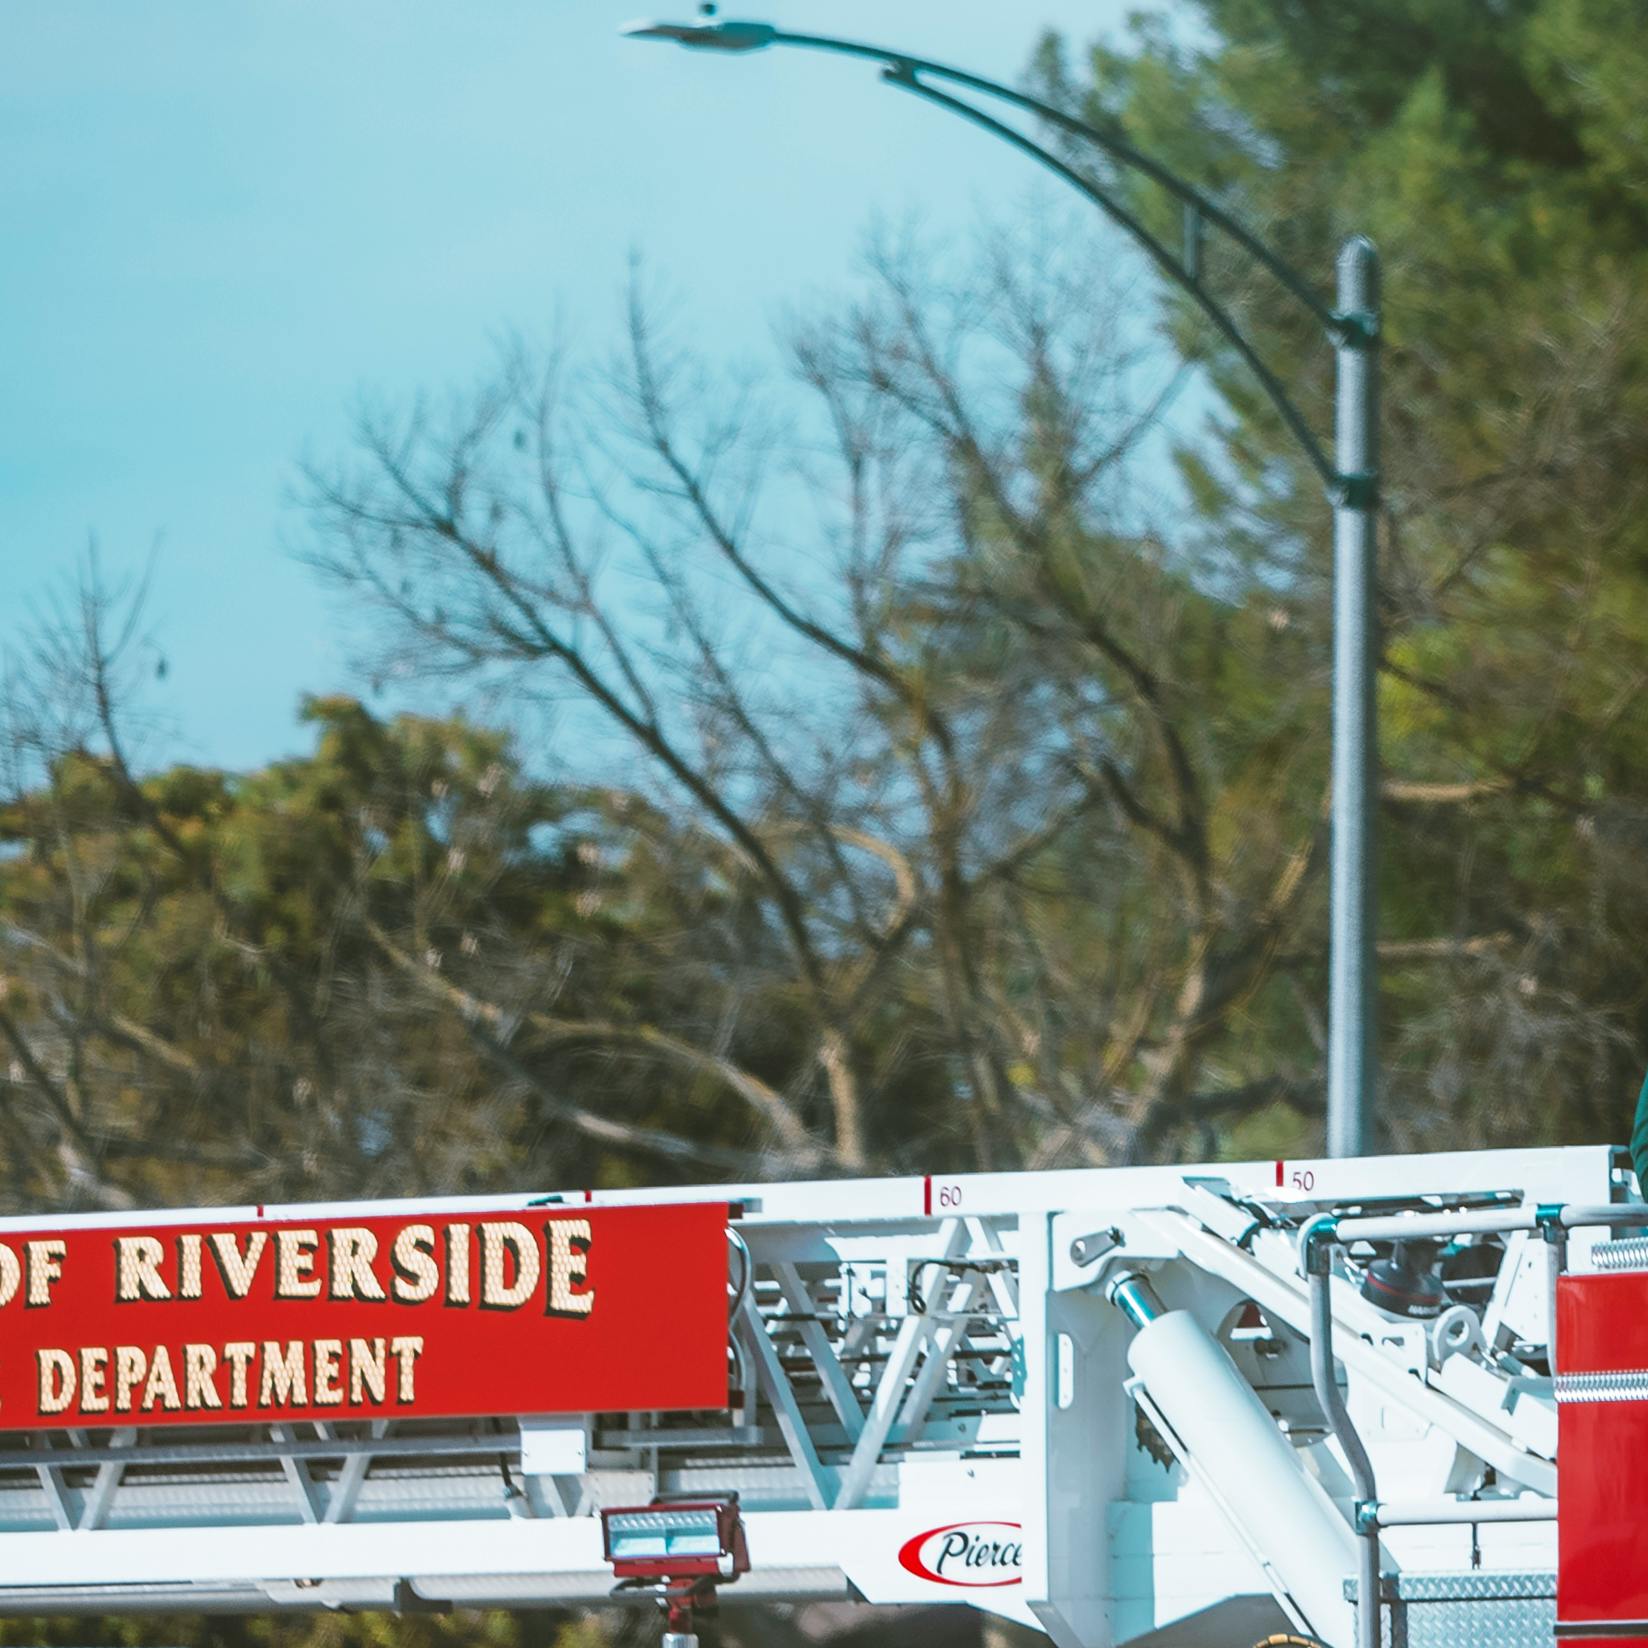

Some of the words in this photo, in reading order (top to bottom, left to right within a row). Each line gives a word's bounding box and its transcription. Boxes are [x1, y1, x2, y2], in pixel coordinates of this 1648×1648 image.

[939, 1185, 963, 1207] 60
[1292, 1170, 1315, 1192] 50
[114, 1219, 595, 1319] RIVERSIDE
[36, 1336, 424, 1414] DEPARTMENT
